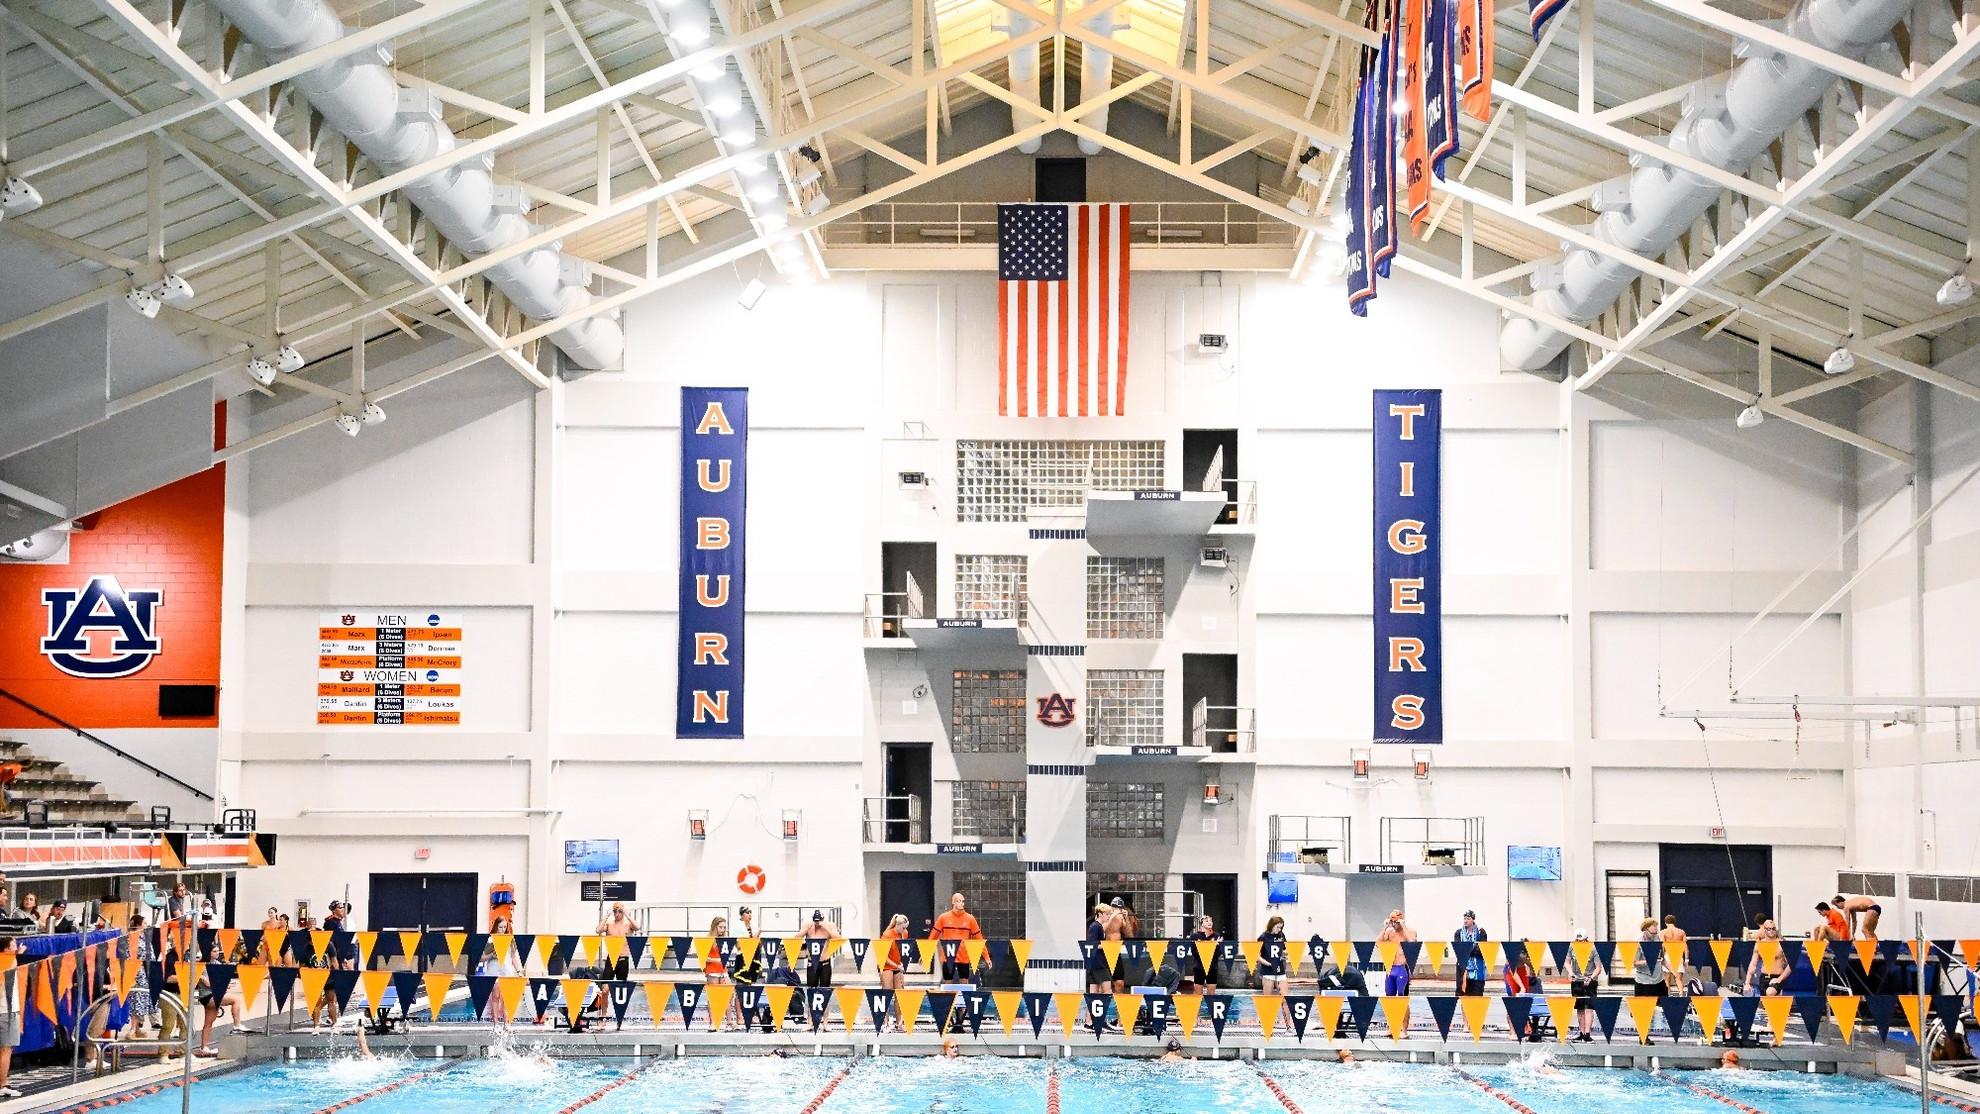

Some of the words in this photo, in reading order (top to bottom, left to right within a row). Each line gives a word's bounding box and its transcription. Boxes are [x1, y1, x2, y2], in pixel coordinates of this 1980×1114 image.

[377, 616, 406, 626] MEN
[693, 402, 734, 724] AUBURN
[1387, 403, 1428, 731] TIGERS
[364, 671, 416, 681] WOMEN
